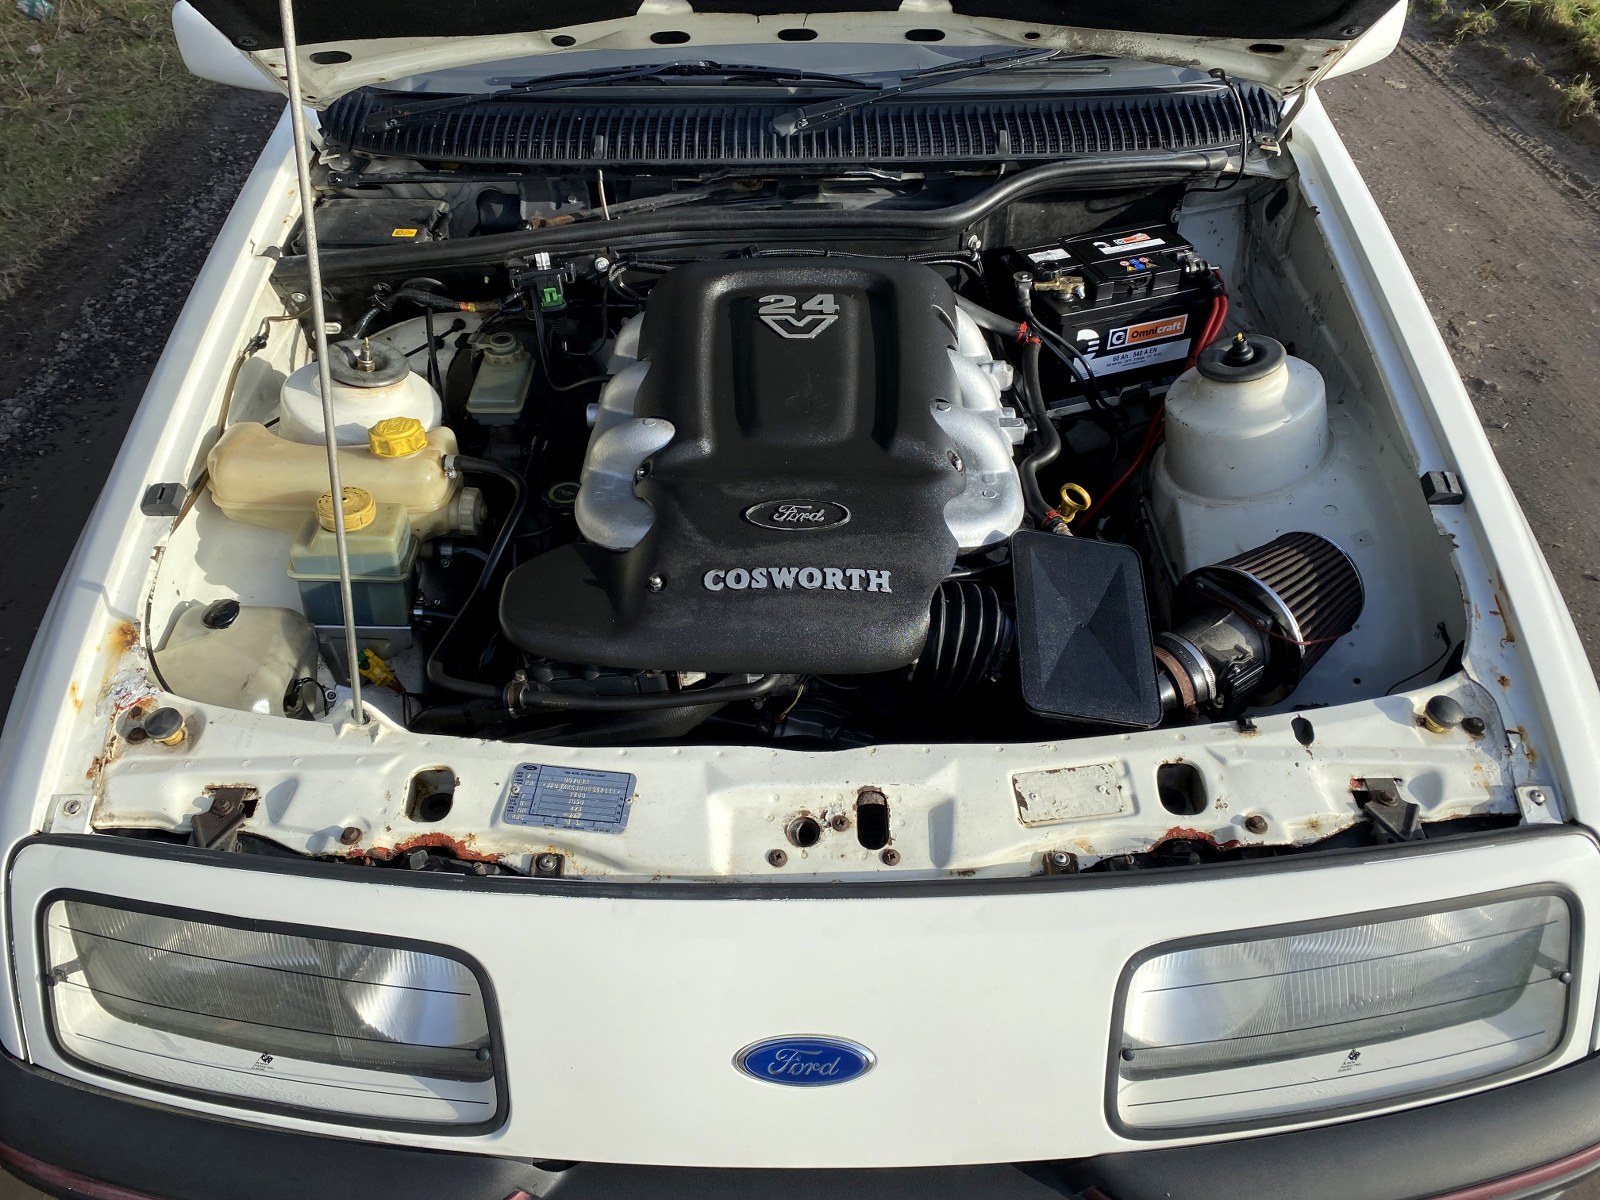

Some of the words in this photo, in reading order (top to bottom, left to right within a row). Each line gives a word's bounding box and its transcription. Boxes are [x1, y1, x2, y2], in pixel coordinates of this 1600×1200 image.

[758, 293, 840, 314] 24
[1130, 321, 1182, 339] Omnicraft
[1148, 346, 1158, 354] EN
[773, 504, 825, 523] Ford
[703, 566, 893, 594] COSWORTH
[767, 1048, 841, 1076] Ford
